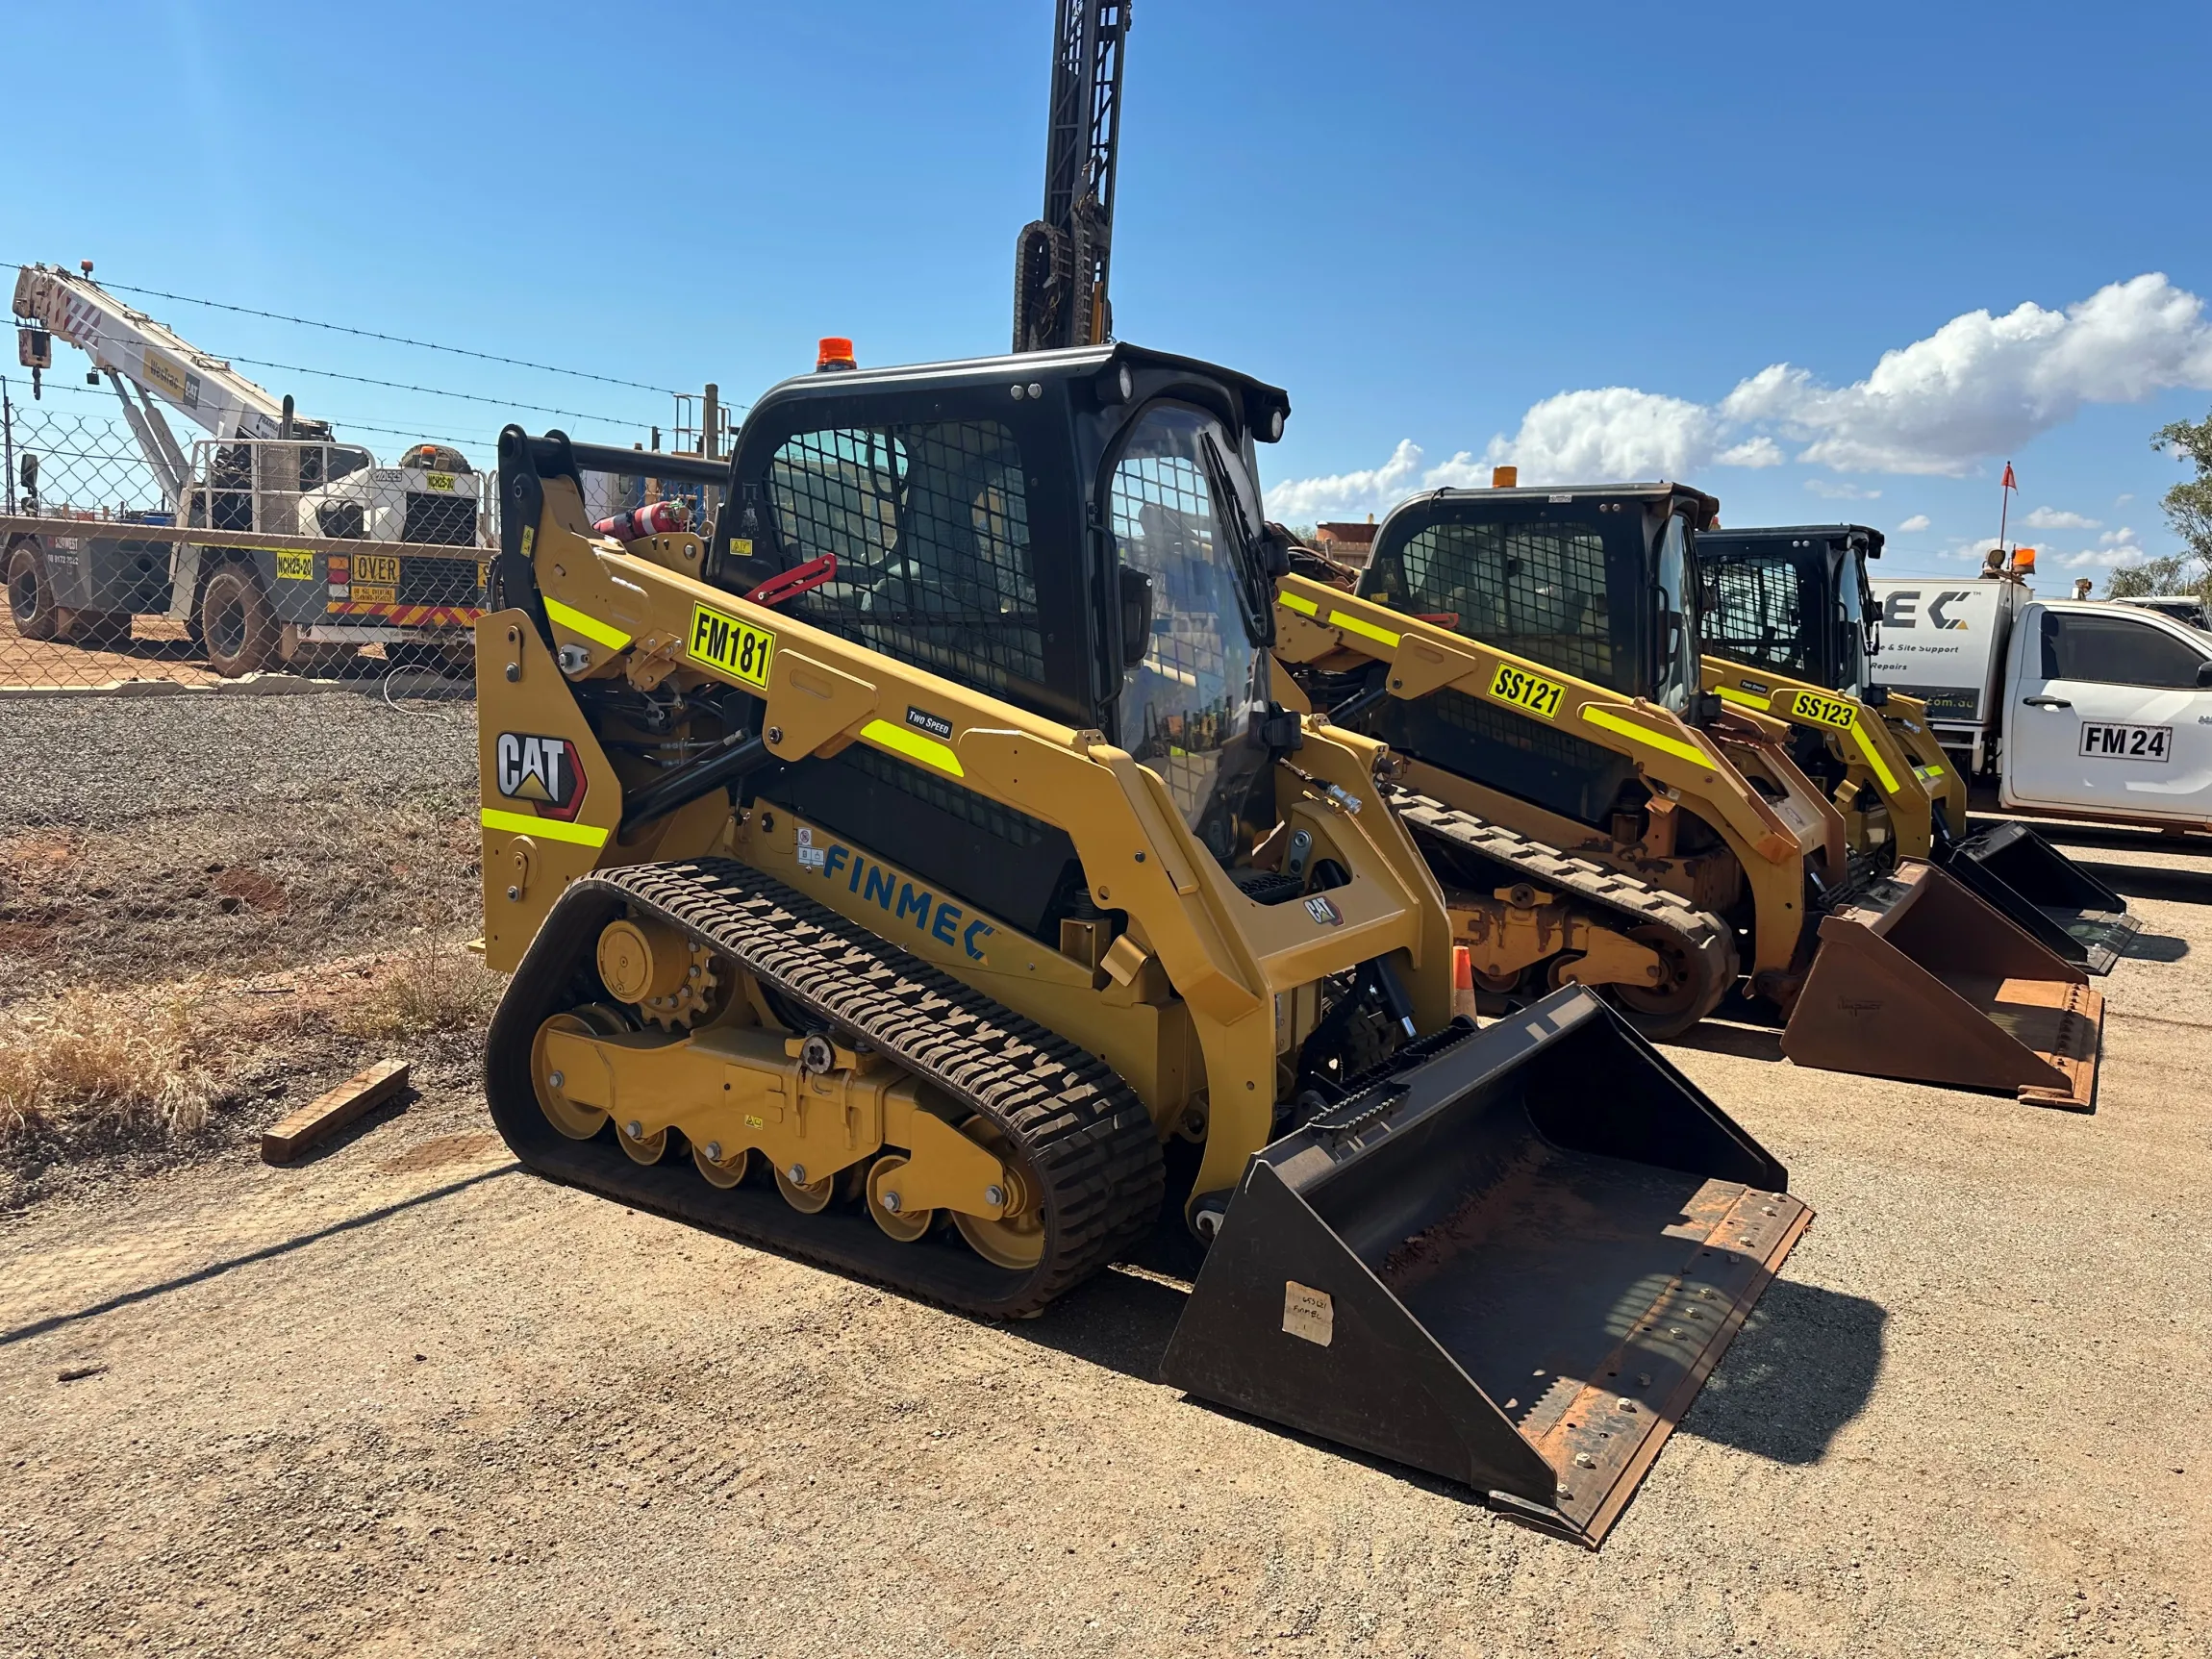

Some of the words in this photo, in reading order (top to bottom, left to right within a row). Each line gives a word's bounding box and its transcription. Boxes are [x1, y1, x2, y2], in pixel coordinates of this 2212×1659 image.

[150, 359, 179, 390] WesTrac
[185, 381, 198, 401] CAT
[359, 557, 396, 580] OVER
[1875, 591, 1972, 630] EC
[694, 612, 768, 679] FM181
[1919, 645, 1959, 654] Support
[1871, 662, 1907, 671] Repairs
[1495, 668, 1561, 714] SS121
[1797, 695, 1853, 726] SS123
[498, 734, 565, 802] CAT
[823, 844, 996, 965] FINMEC
[1304, 896, 1336, 923] CAT
